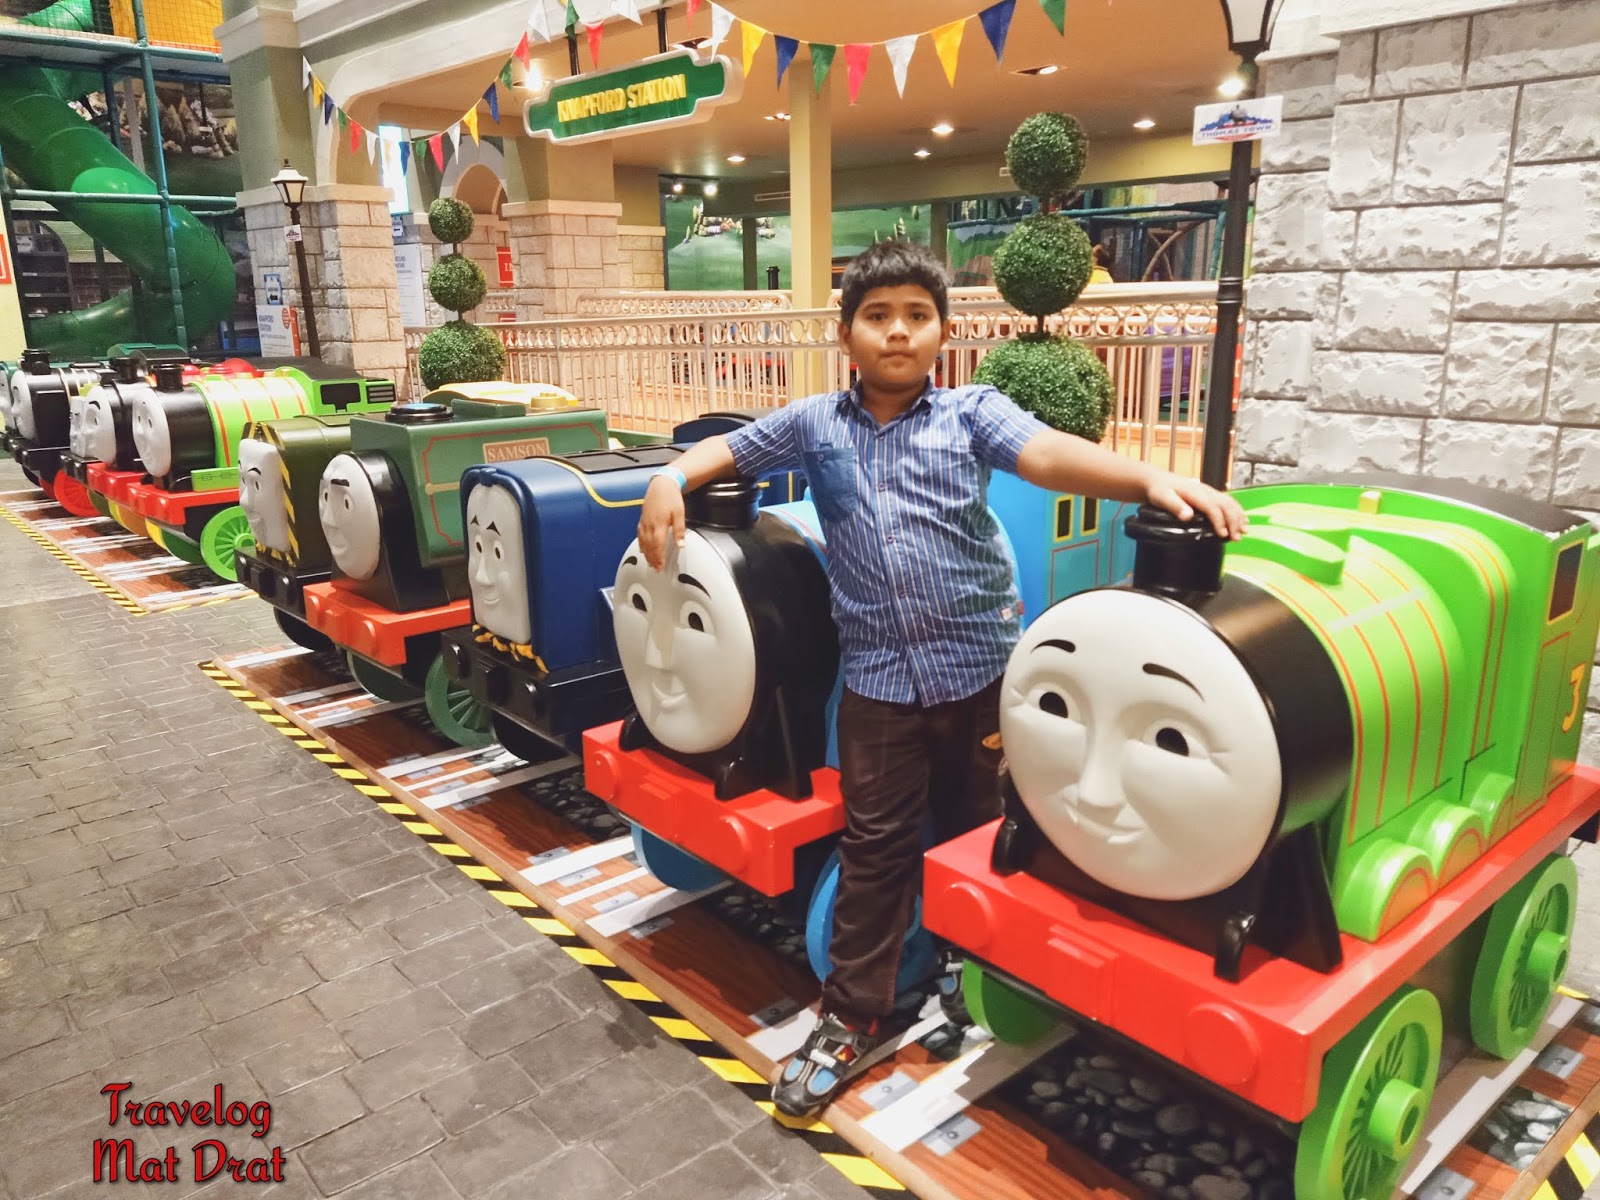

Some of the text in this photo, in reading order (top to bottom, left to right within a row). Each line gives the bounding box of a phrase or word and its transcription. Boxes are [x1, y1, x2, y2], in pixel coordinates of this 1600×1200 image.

[556, 73, 687, 123] KNAPFORD STATION
[1201, 124, 1273, 139] THOMAS TOWN
[487, 443, 546, 463] SAMSON
[1561, 661, 1586, 734] 3
